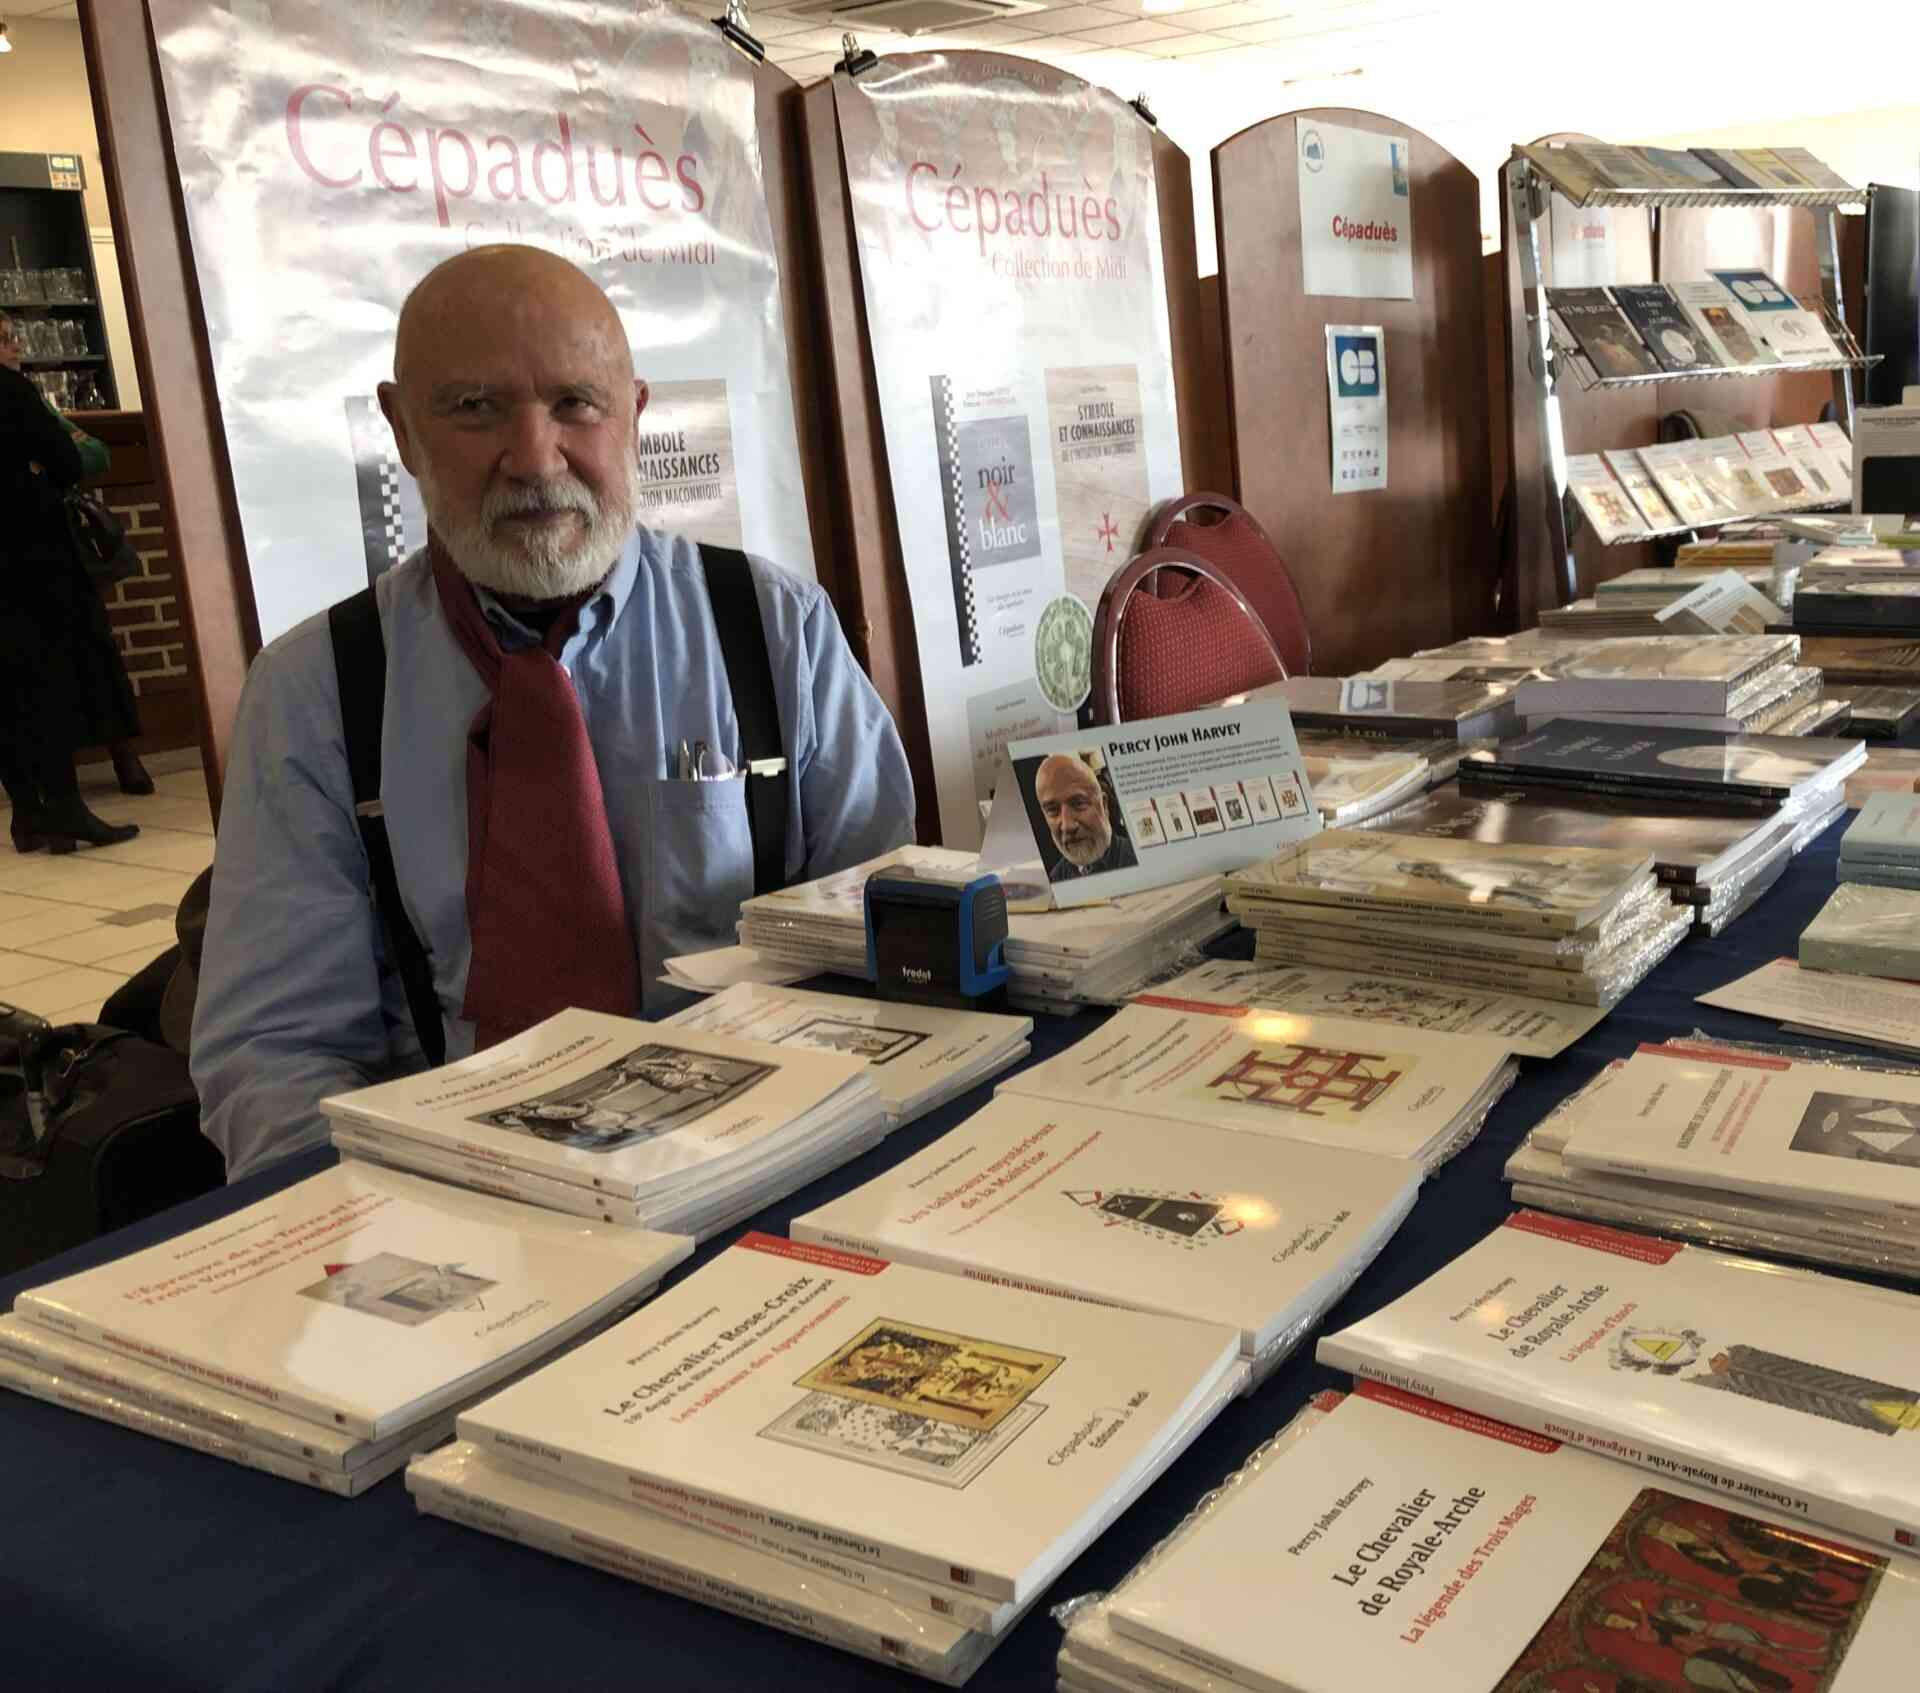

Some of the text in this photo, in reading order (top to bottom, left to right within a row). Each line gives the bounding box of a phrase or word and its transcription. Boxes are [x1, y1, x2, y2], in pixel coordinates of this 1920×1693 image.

[286, 82, 706, 228] Cépaduès
[905, 160, 1121, 258] Cépaduès
[1332, 214, 1399, 242] Cépaduès
[991, 250, 1128, 281] Collection de Midi
[1078, 402, 1114, 421] SYMBOLE
[639, 431, 685, 456] MBOLE
[1058, 418, 1136, 443] ET CONNAISSANCES
[638, 453, 720, 482] NAISSANCES
[977, 456, 1016, 489] noir
[984, 480, 1013, 522] &
[979, 515, 1027, 552] blanc
[1154, 732, 1189, 752] JOHN
[1191, 722, 1241, 742] HARVEY
[927, 1173, 990, 1209] tableaux
[1487, 1285, 1568, 1340] Le Chevalier
[1509, 1285, 1609, 1358] de Royale-Arche
[603, 1277, 813, 1416] Le Chevalier Rose-Croix
[1560, 1303, 1638, 1362] La légende d'Enoch
[670, 1296, 850, 1423] Les tableaux des Appartements
[1543, 1424, 1584, 1449] d'Enoch
[1586, 1436, 1626, 1461] légende
[1646, 1453, 1718, 1487] Royale-Arche
[1737, 1479, 1791, 1508] Chevalier
[1794, 1495, 1808, 1513] Le
[768, 1514, 819, 1539] Rose-Croix
[1288, 1478, 1374, 1555] Percy John Harvey
[821, 1529, 866, 1552] Chevalier
[1332, 1489, 1436, 1586] Le Chevalier
[1358, 1488, 1485, 1616] de Royale-Arche
[1401, 1494, 1537, 1643] La légende des Trois Mages
